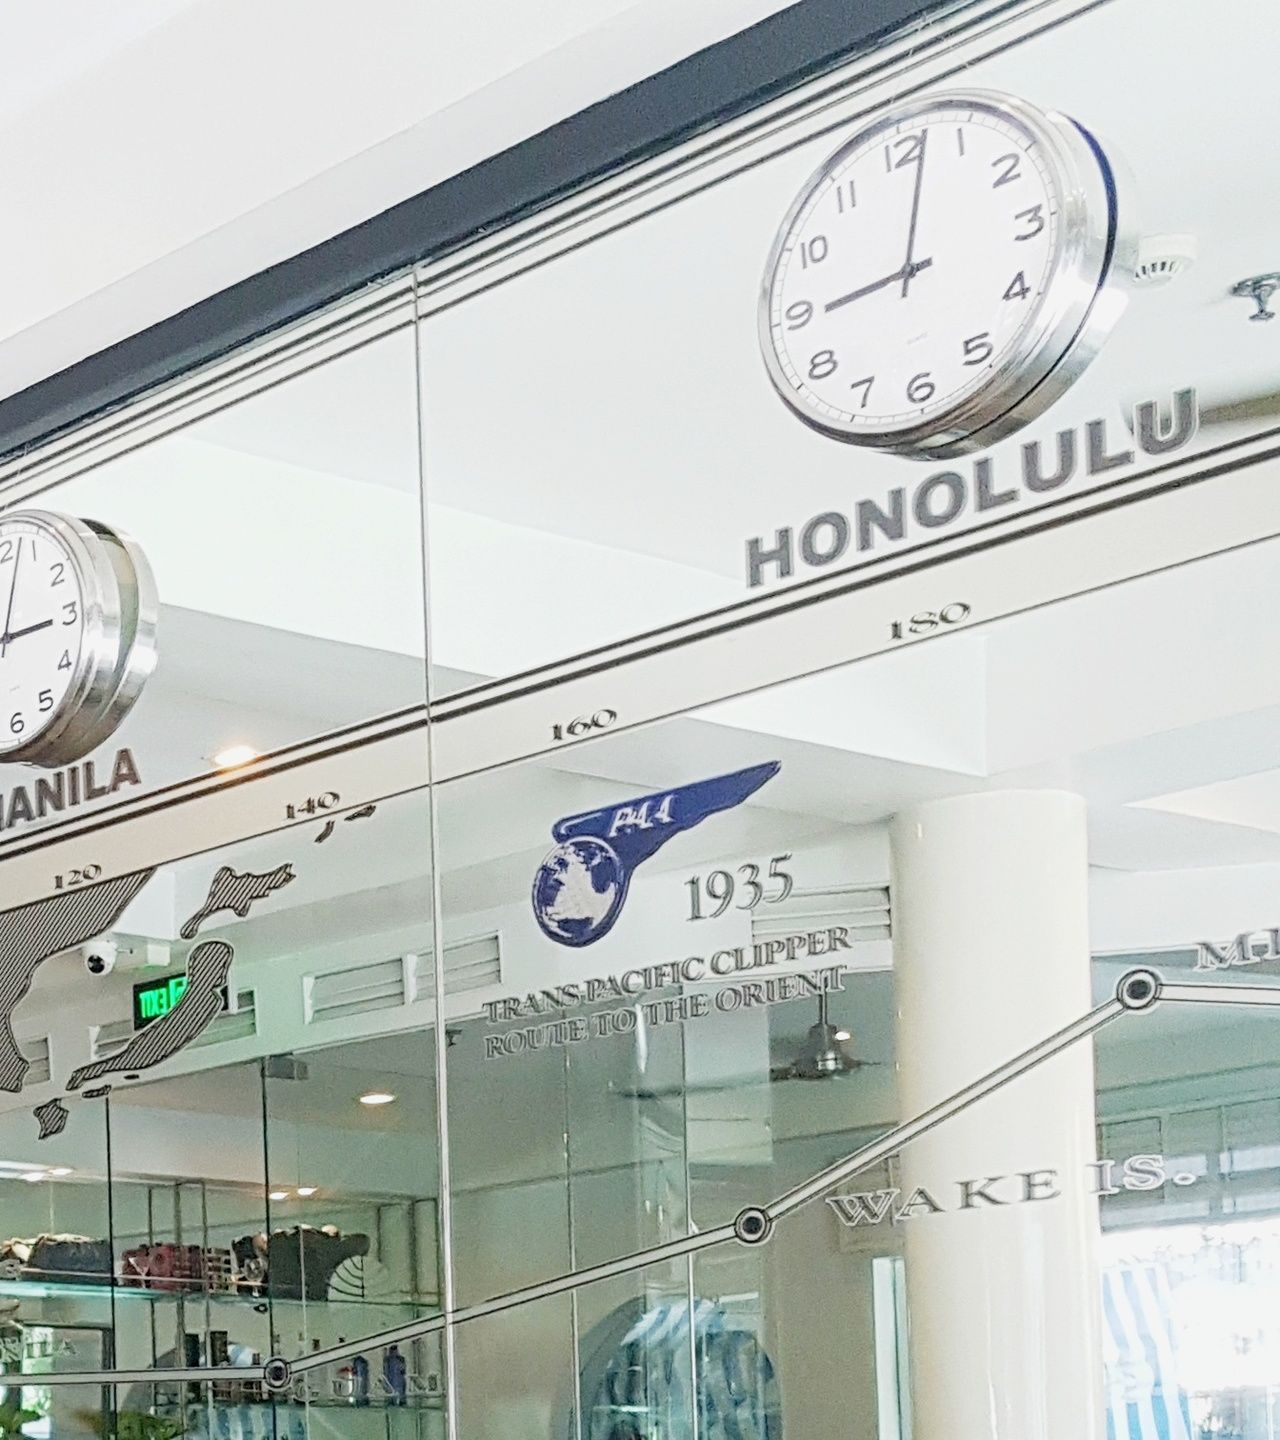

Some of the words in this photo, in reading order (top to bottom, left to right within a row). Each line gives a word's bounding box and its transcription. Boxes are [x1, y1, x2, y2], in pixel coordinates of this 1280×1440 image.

[884, 135, 921, 172] 12
[956, 128, 965, 156] 1
[991, 152, 1022, 188] 2
[836, 180, 857, 213] 11
[1014, 204, 1044, 241] 3
[800, 235, 828, 269] 10
[1002, 272, 1031, 301] 4
[785, 301, 814, 330] 9
[808, 350, 838, 380] 8
[962, 333, 993, 366] 5
[850, 376, 875, 408] 7
[907, 372, 935, 403] 6
[746, 387, 1198, 588] HONOLULU
[31, 540, 38, 561] 1
[49, 563, 65, 587] 2
[62, 601, 78, 626] 3
[889, 602, 971, 640] 180
[57, 649, 72, 671] 4
[38, 690, 53, 711] 5
[10, 713, 24, 734] 6
[551, 708, 618, 740] 160
[286, 791, 341, 819] 140
[54, 864, 102, 889] 120
[685, 853, 794, 922] 1935
[709, 926, 853, 976] CLIPPER
[484, 1018, 590, 1059] ROUTE
[590, 1005, 638, 1038] TO
[639, 991, 712, 1028] THE
[714, 963, 848, 1014] ORIENT
[826, 1167, 1061, 1227] WAKE
[1089, 1153, 1197, 1196] IS.
